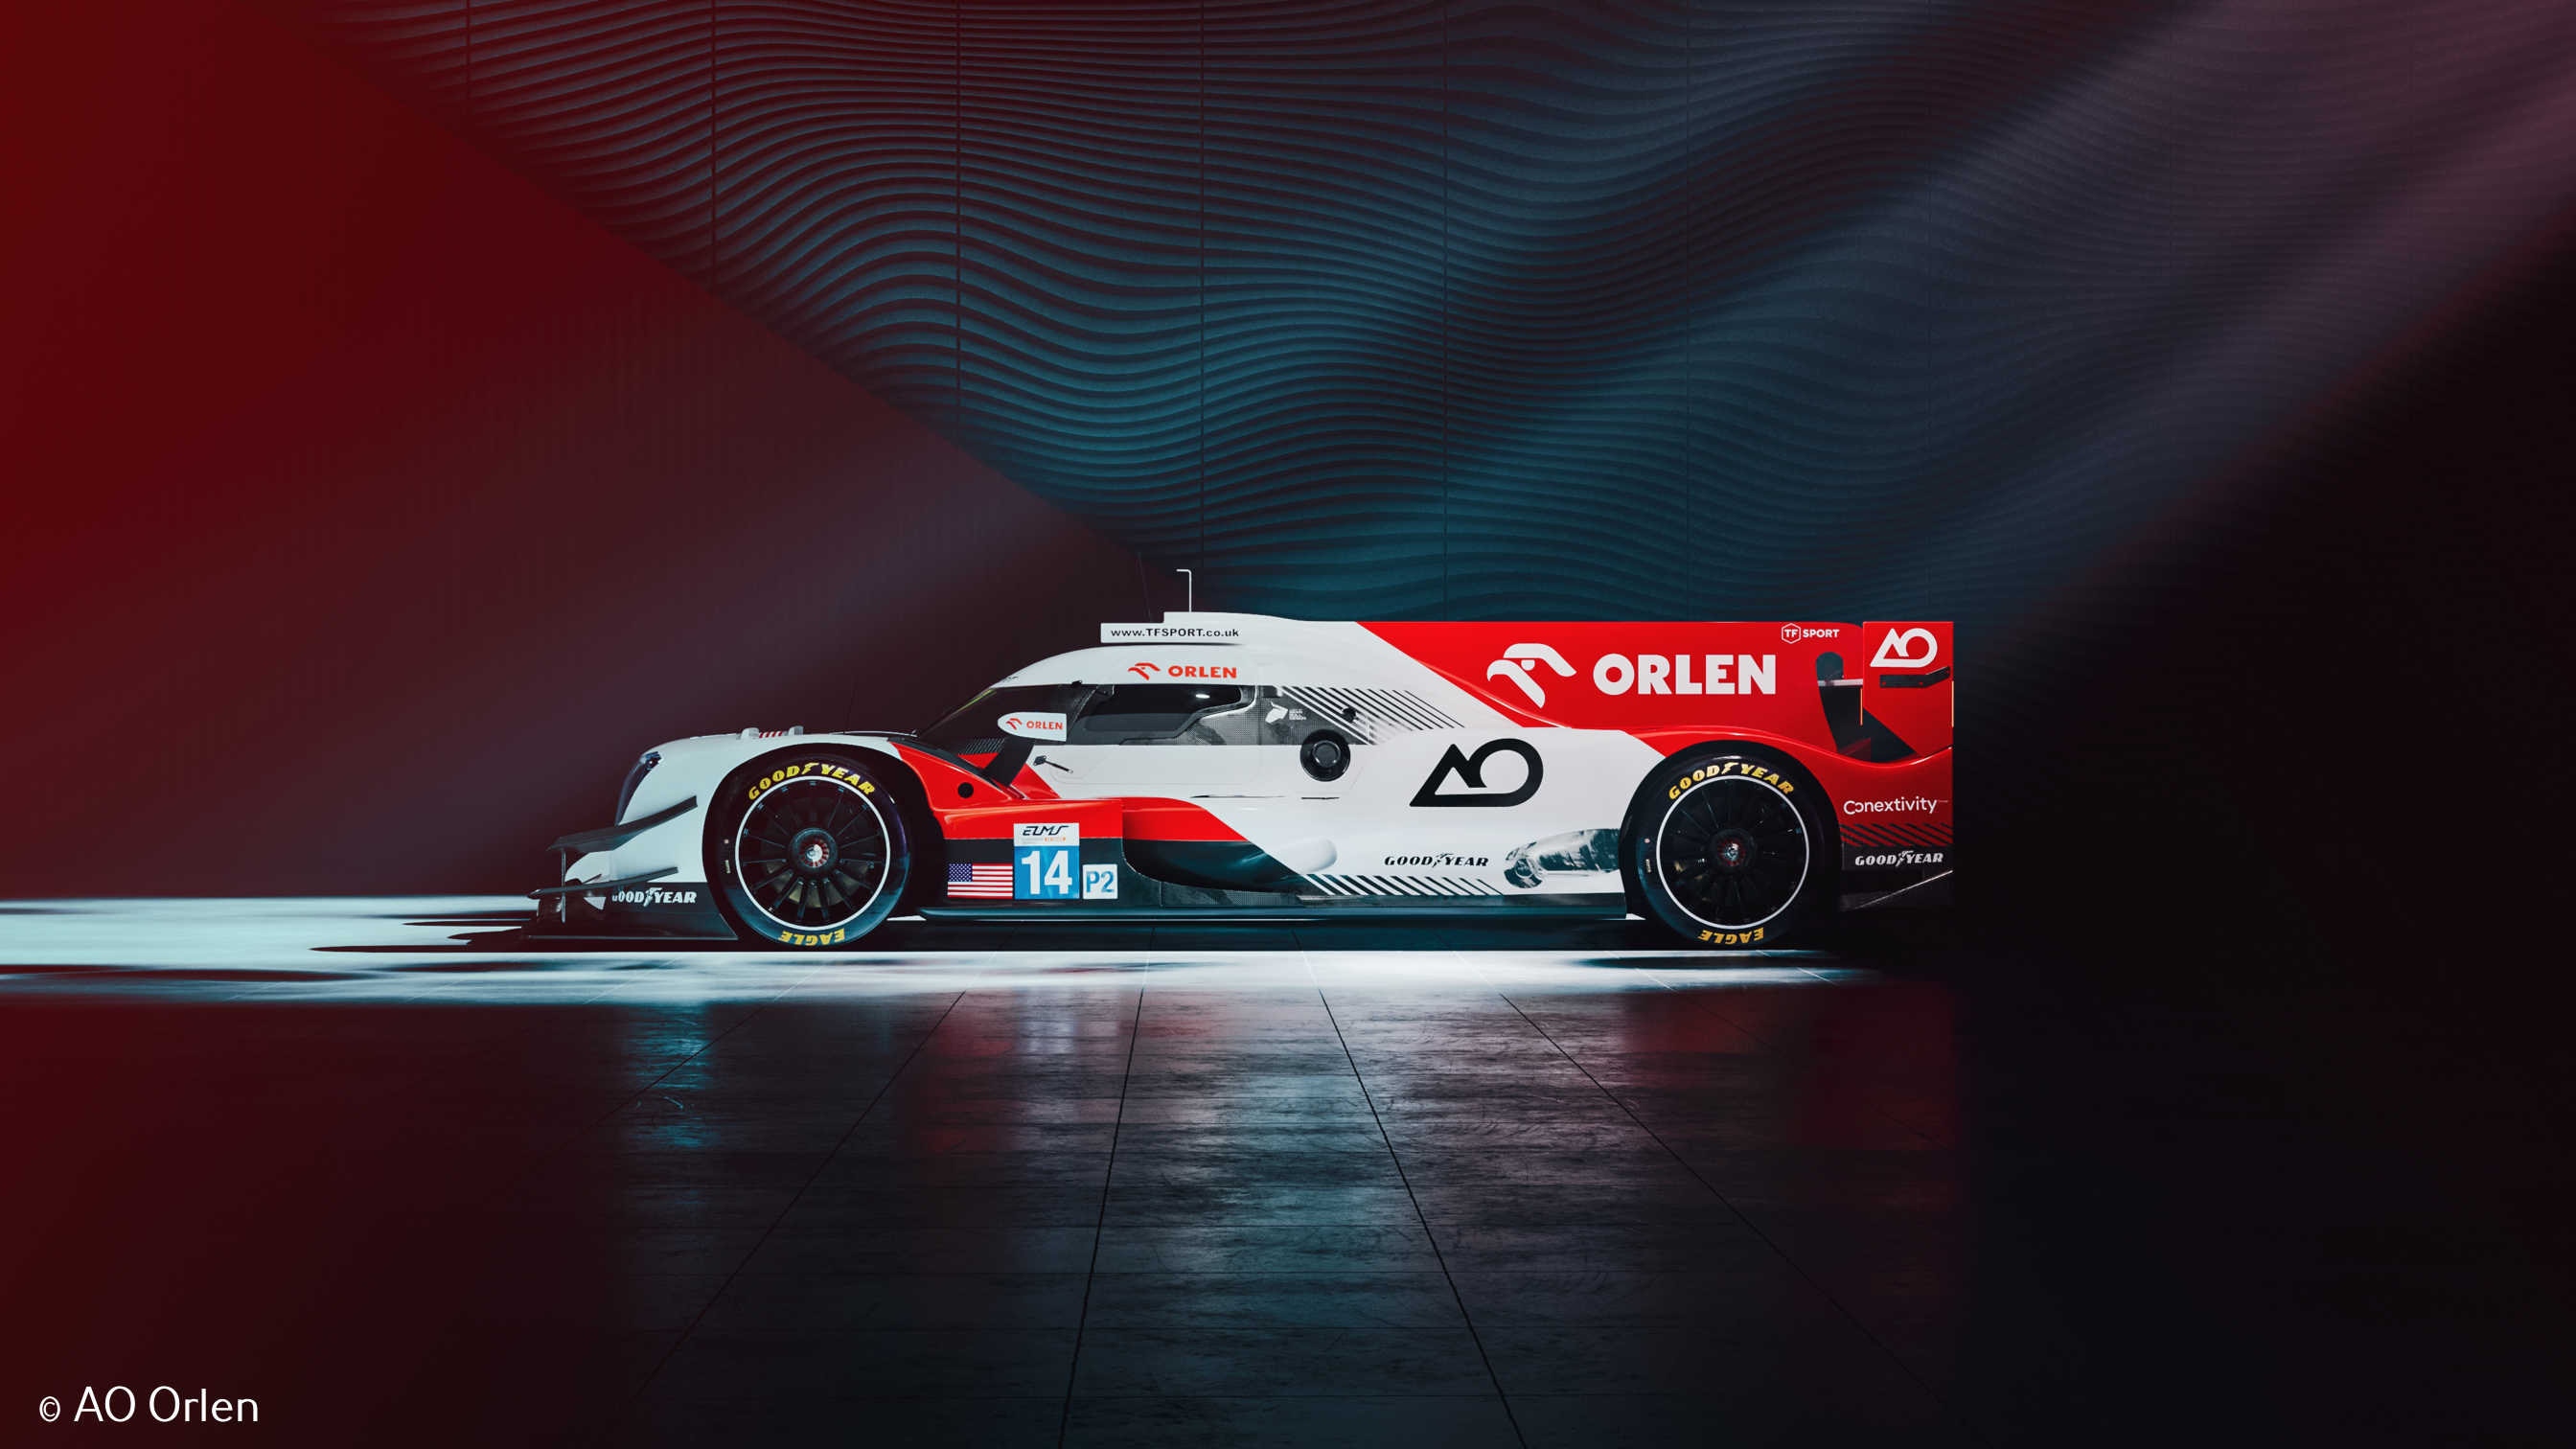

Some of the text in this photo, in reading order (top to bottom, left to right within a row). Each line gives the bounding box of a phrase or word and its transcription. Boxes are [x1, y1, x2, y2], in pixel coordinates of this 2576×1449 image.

[1111, 628, 1239, 637] www.TFSPORT.co.uk
[1783, 629, 1840, 638] TF SPORT
[1167, 665, 1237, 678] ORLEN
[1593, 653, 1776, 695] ORLEN
[1026, 721, 1063, 730] ORLEN
[1384, 853, 1489, 867] GOODYEAR
[1854, 850, 1944, 867] GOODYEAR
[1021, 850, 1073, 895] 14
[1086, 870, 1115, 893] P2
[778, 928, 845, 946] EAGLE
[1697, 928, 1763, 945] EAGLE
